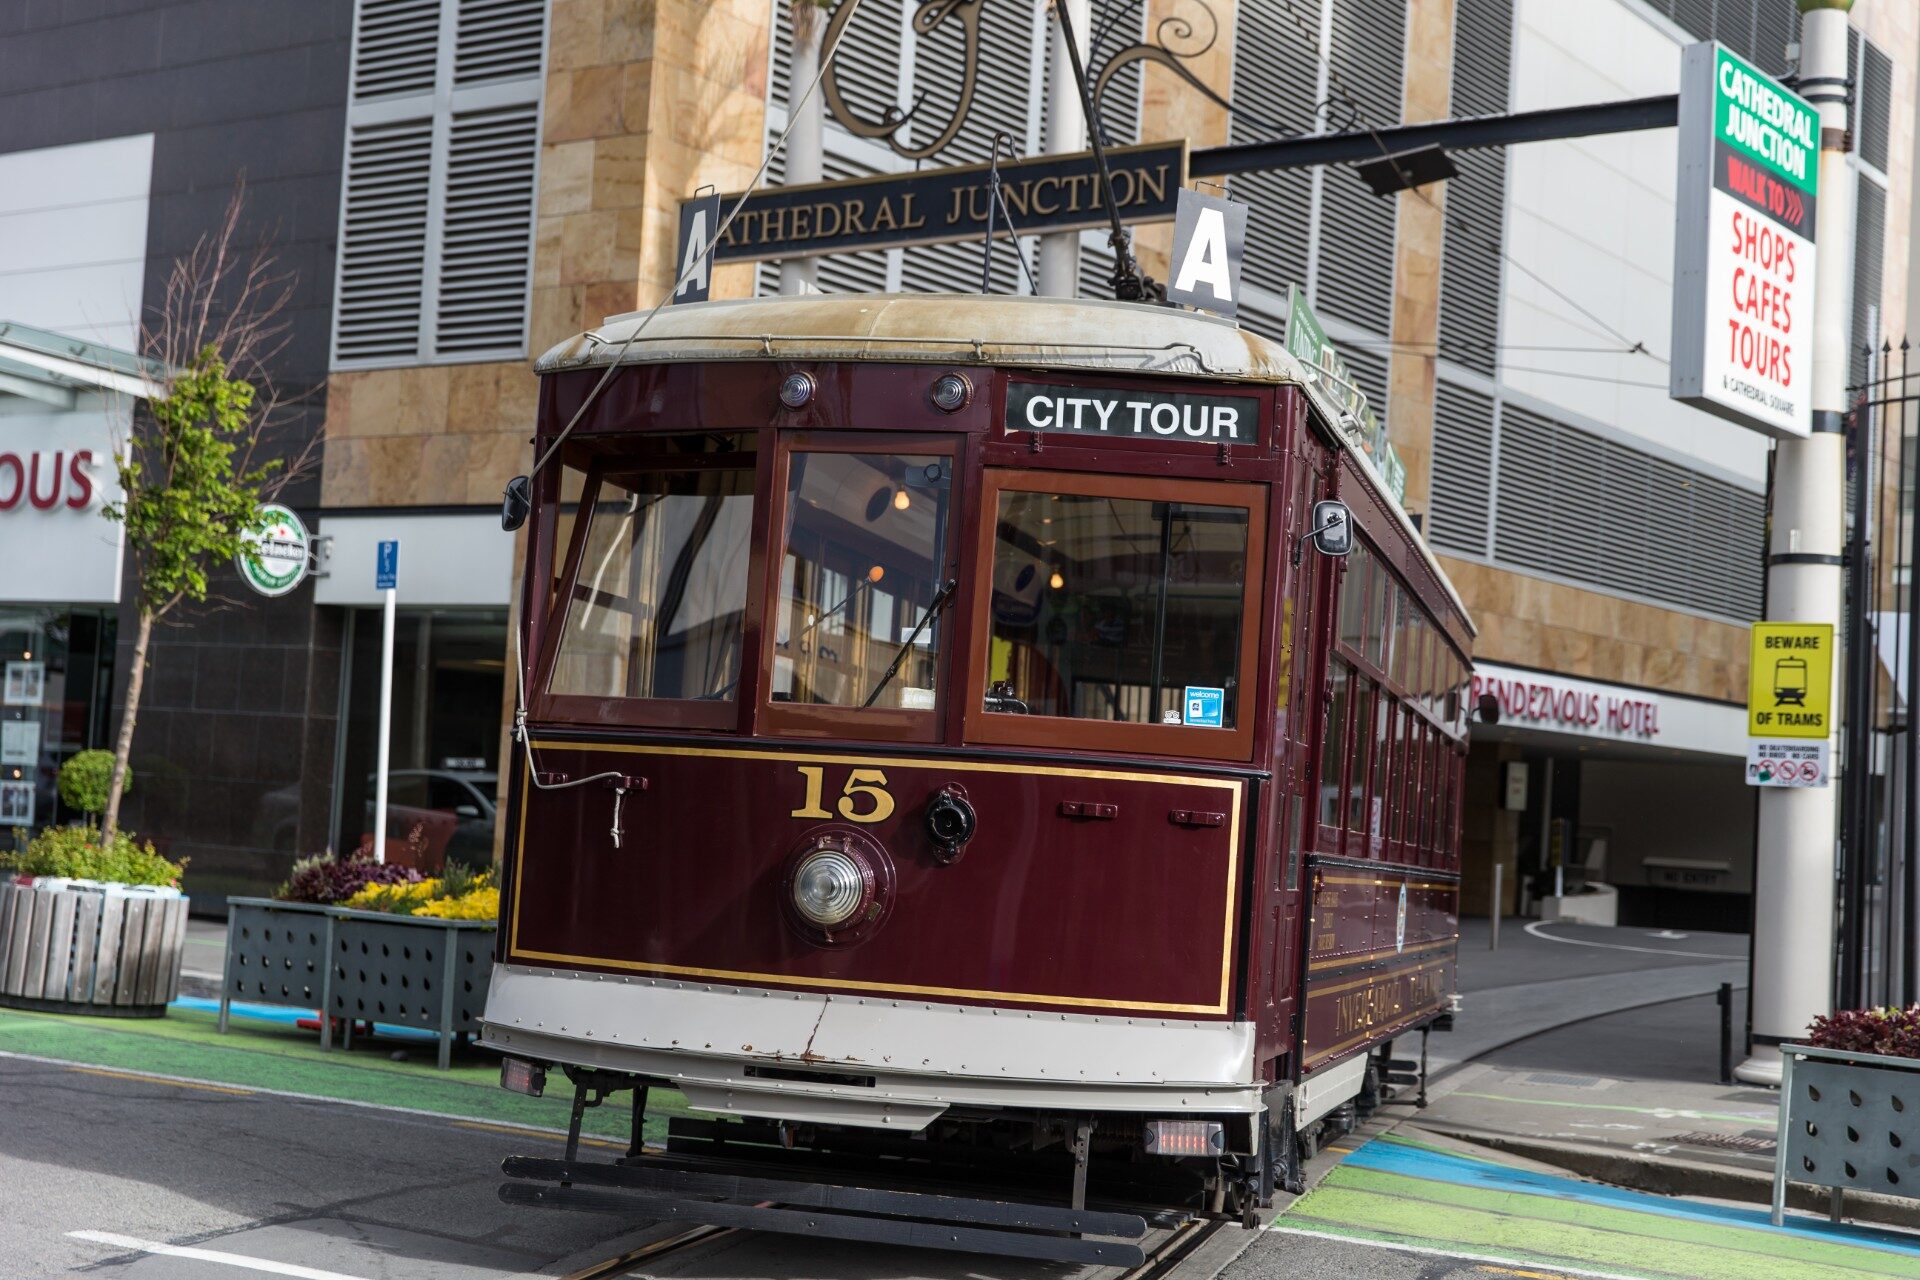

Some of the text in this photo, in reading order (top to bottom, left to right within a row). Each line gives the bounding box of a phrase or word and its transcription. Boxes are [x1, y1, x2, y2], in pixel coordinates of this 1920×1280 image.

[1720, 61, 1815, 149] CATHEDRAL
[1725, 103, 1806, 180] JUNCTION
[714, 165, 1171, 246] ATHEDRAL JUNCTION
[1727, 155, 1785, 217] WALK TO
[676, 210, 706, 296] A
[1173, 206, 1233, 300] A
[1731, 211, 1795, 283] SHOPS
[1732, 267, 1791, 334] CAFES
[1729, 318, 1791, 387] TOURS
[1026, 396, 1239, 438] CITY TOUR
[383, 542, 393, 559] P
[1765, 636, 1820, 649] BEWARE
[1189, 690, 1220, 699] welcome
[1606, 696, 1660, 735] HOTEL
[1756, 711, 1823, 726] OF TRAMS
[791, 766, 895, 823] 15
